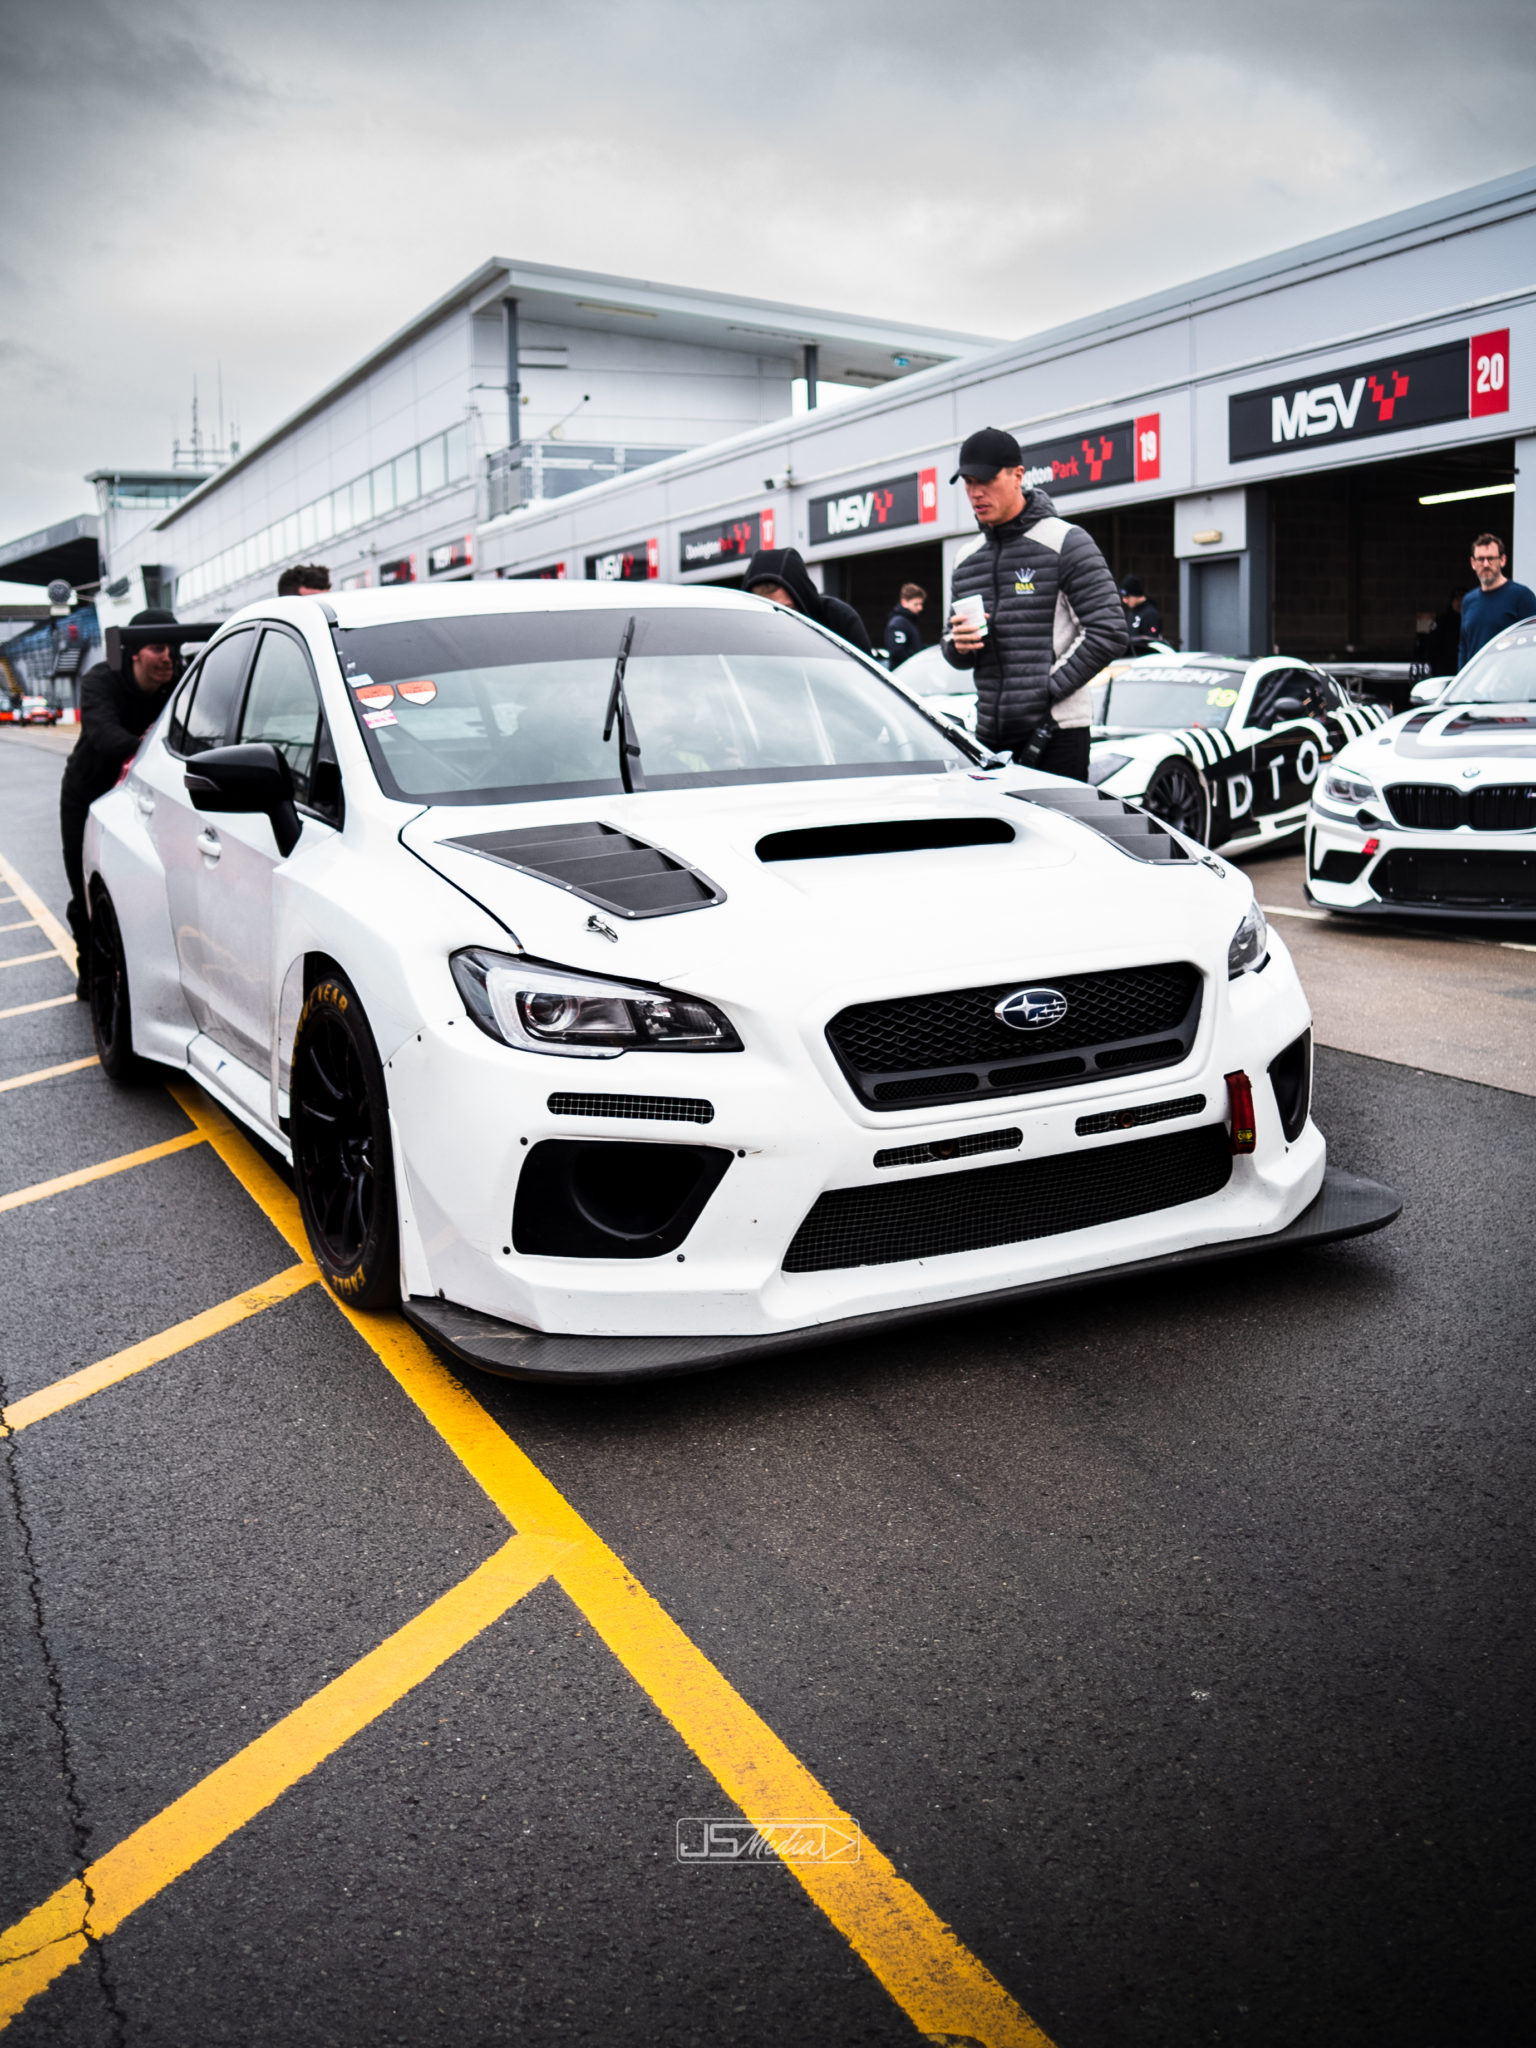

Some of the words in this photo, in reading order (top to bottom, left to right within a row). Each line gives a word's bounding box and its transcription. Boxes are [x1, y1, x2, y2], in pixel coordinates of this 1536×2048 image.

[1477, 353, 1505, 393] 20
[1271, 377, 1366, 443] MSV
[1139, 430, 1158, 462] 19
[827, 491, 874, 535] MSV
